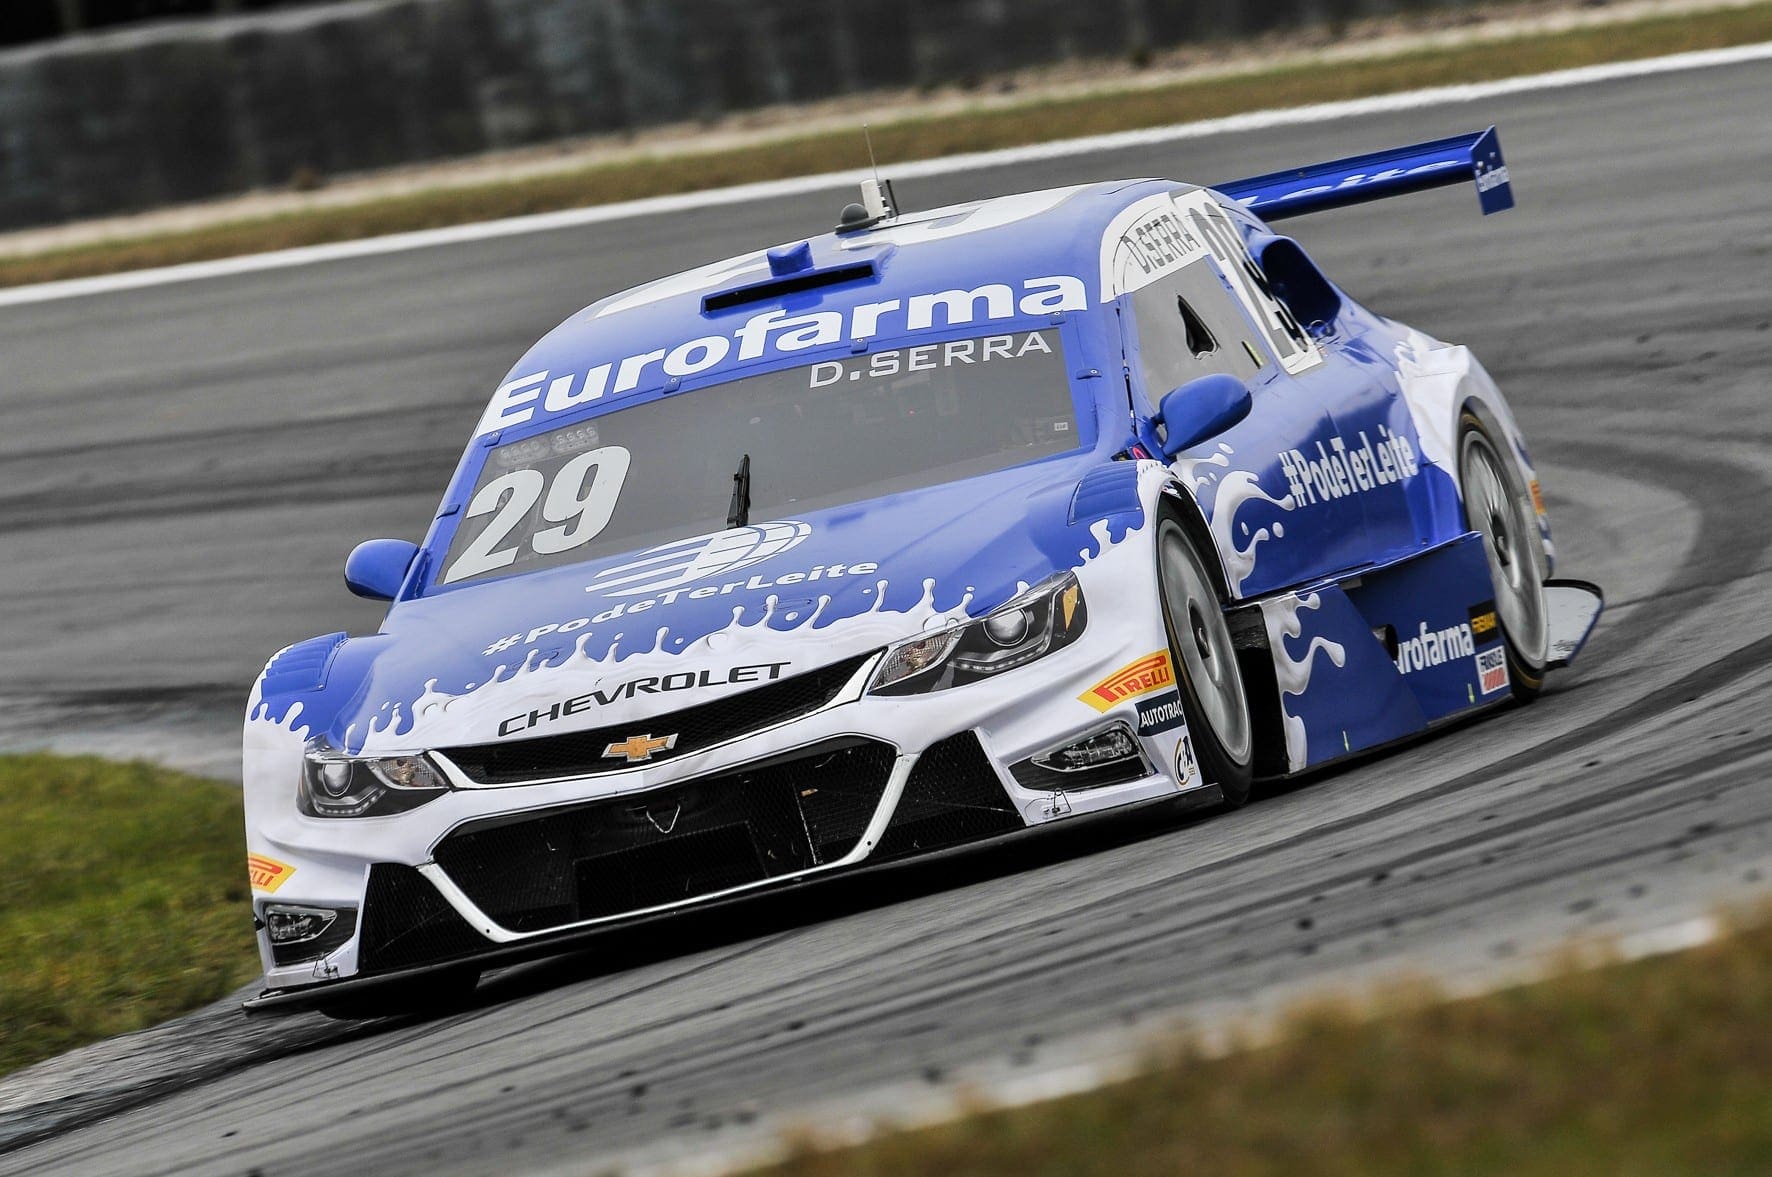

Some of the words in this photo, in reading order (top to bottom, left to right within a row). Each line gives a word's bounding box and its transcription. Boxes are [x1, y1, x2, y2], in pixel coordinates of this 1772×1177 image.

[1120, 212, 1201, 274] D.SERRA
[478, 275, 1088, 437] Eurofarma
[808, 330, 1053, 389] D.SERRA
[1278, 423, 1419, 508] #PodeTerLeite
[443, 445, 632, 585] 29
[482, 561, 878, 657] #PodeTerLeite
[1092, 654, 1170, 703] PIRELLI
[1393, 621, 1475, 674] urofarma
[497, 661, 792, 737] CHEVROLET
